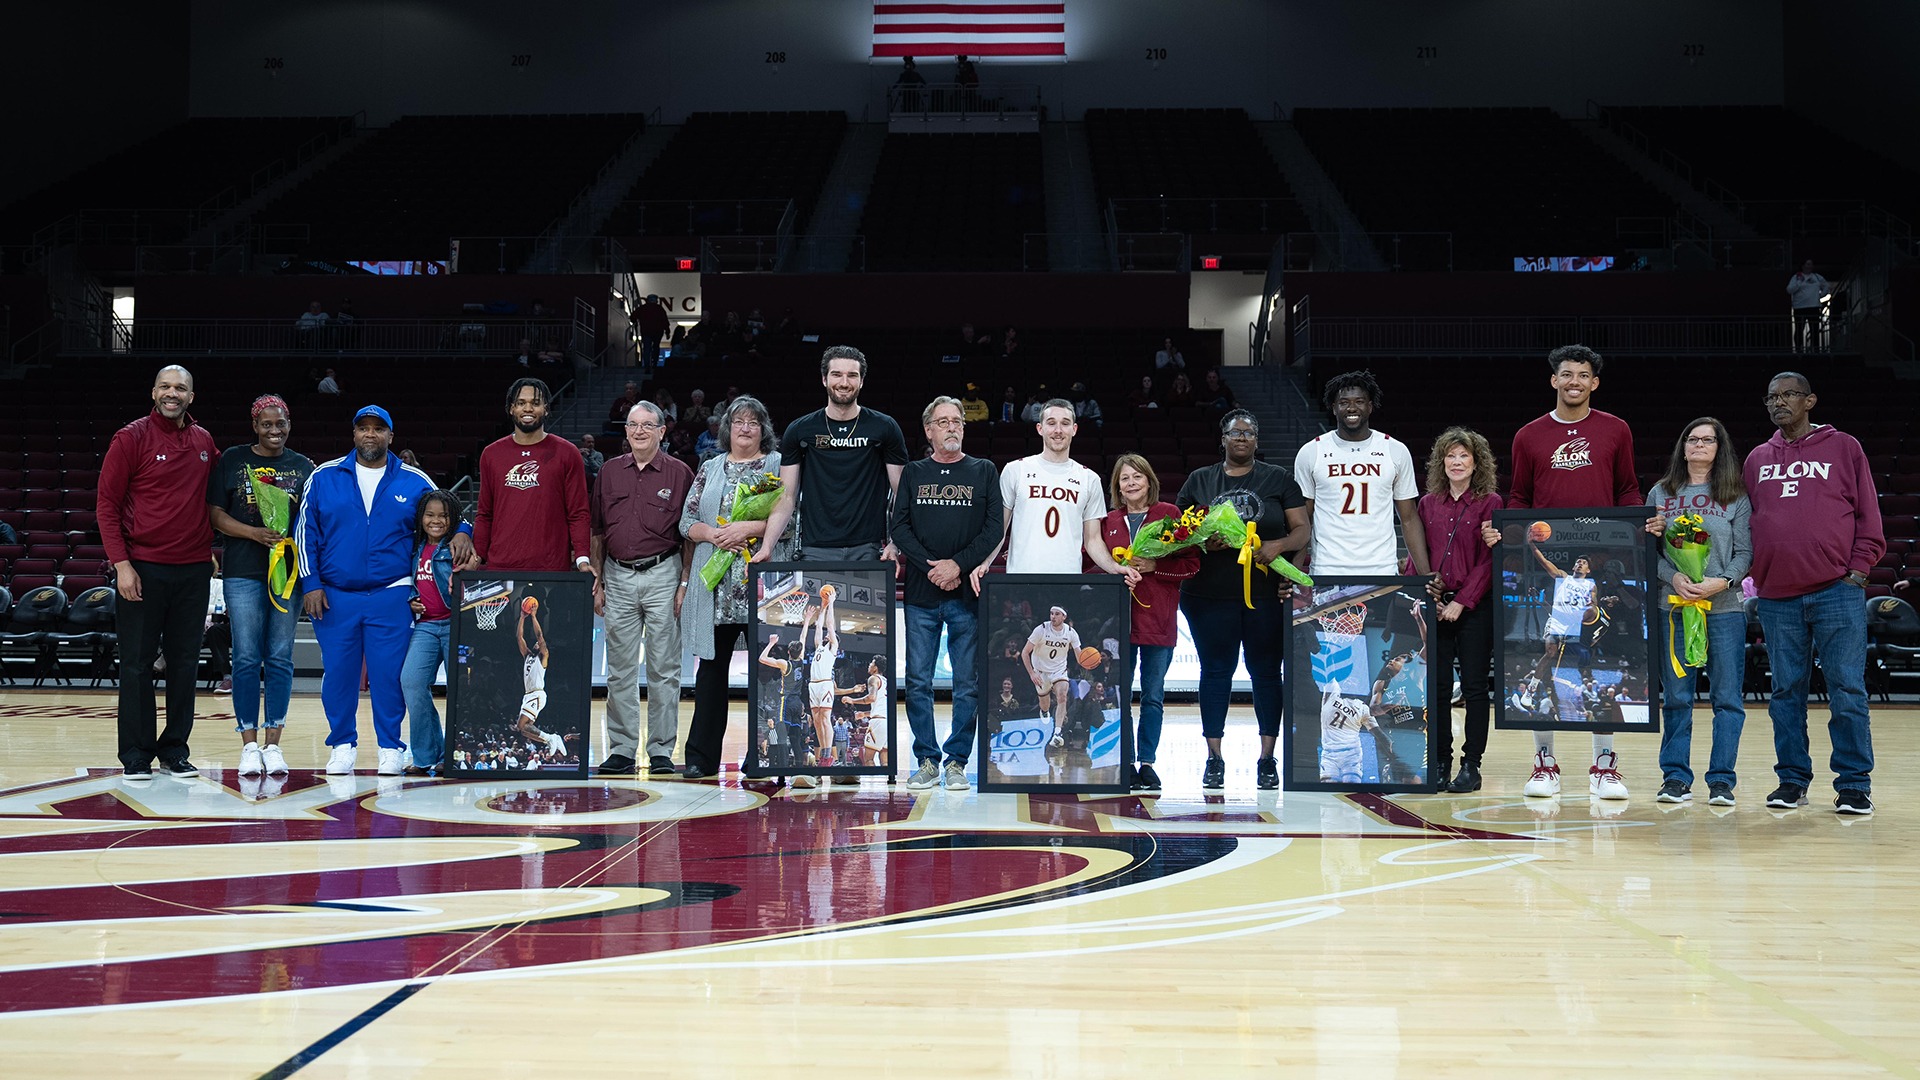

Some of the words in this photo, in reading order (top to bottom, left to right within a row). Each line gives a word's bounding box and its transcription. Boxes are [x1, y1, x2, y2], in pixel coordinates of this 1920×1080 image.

[1146, 48, 1167, 60] 210
[1417, 47, 1437, 58] 211
[1684, 45, 1704, 56] 212
[264, 58, 284, 69] 206
[512, 55, 531, 66] 207
[765, 52, 786, 63] 208
[680, 260, 692, 269] EXIT
[815, 434, 869, 448] EQUALITY
[1556, 450, 1590, 463] ELON
[1327, 463, 1381, 478] ELON
[1758, 461, 1832, 484] ELON
[509, 473, 539, 482] ELON
[917, 484, 974, 500] ELON
[1028, 485, 1079, 504] ELON
[1780, 481, 1799, 498] E
[916, 499, 973, 507] BASKETBALL
[1340, 482, 1370, 515] 21
[1044, 505, 1060, 538] 0
[1046, 640, 1067, 649] ELON
[1049, 649, 1057, 660] 0
[1332, 700, 1357, 718] ELON
[1329, 711, 1347, 730] 21
